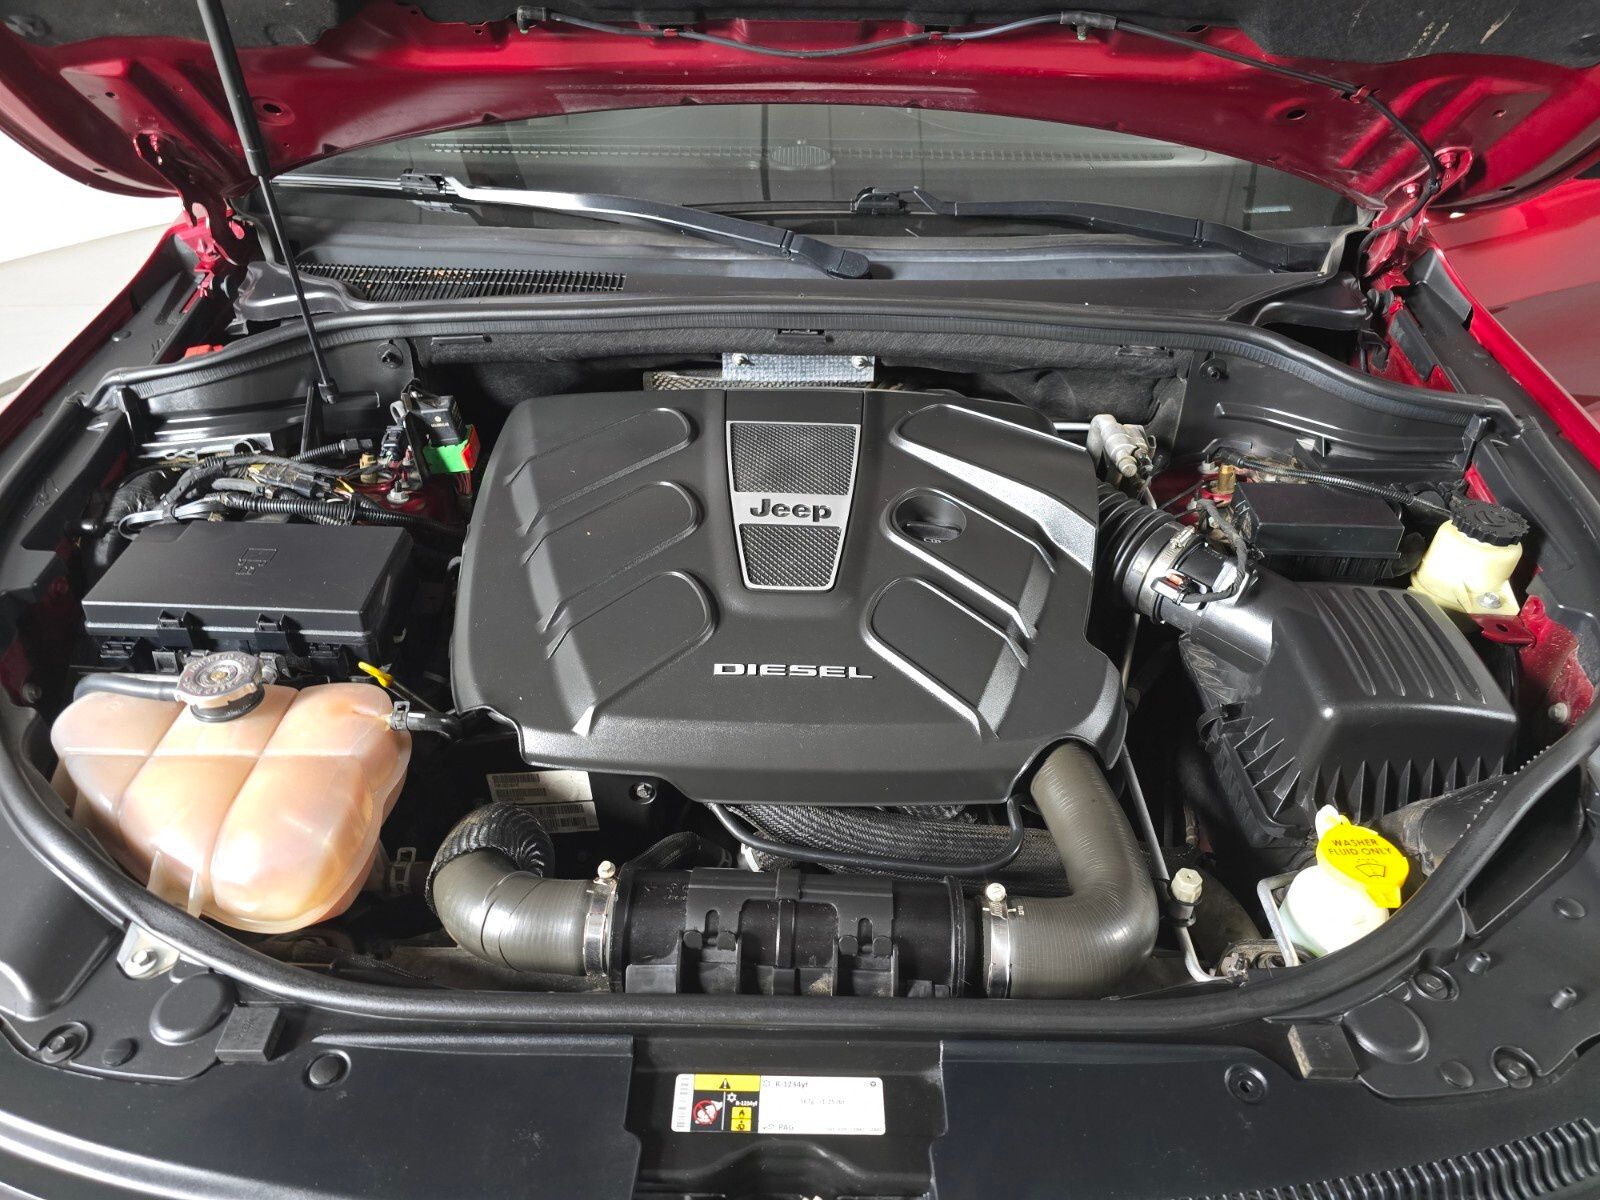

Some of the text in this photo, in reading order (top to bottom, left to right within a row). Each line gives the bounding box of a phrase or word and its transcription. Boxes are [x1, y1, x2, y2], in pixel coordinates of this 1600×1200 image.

[749, 498, 832, 522] Jeep
[713, 663, 875, 679] DIESEL
[1331, 839, 1378, 847] WASHER
[1328, 847, 1392, 856] FLUID ONLY
